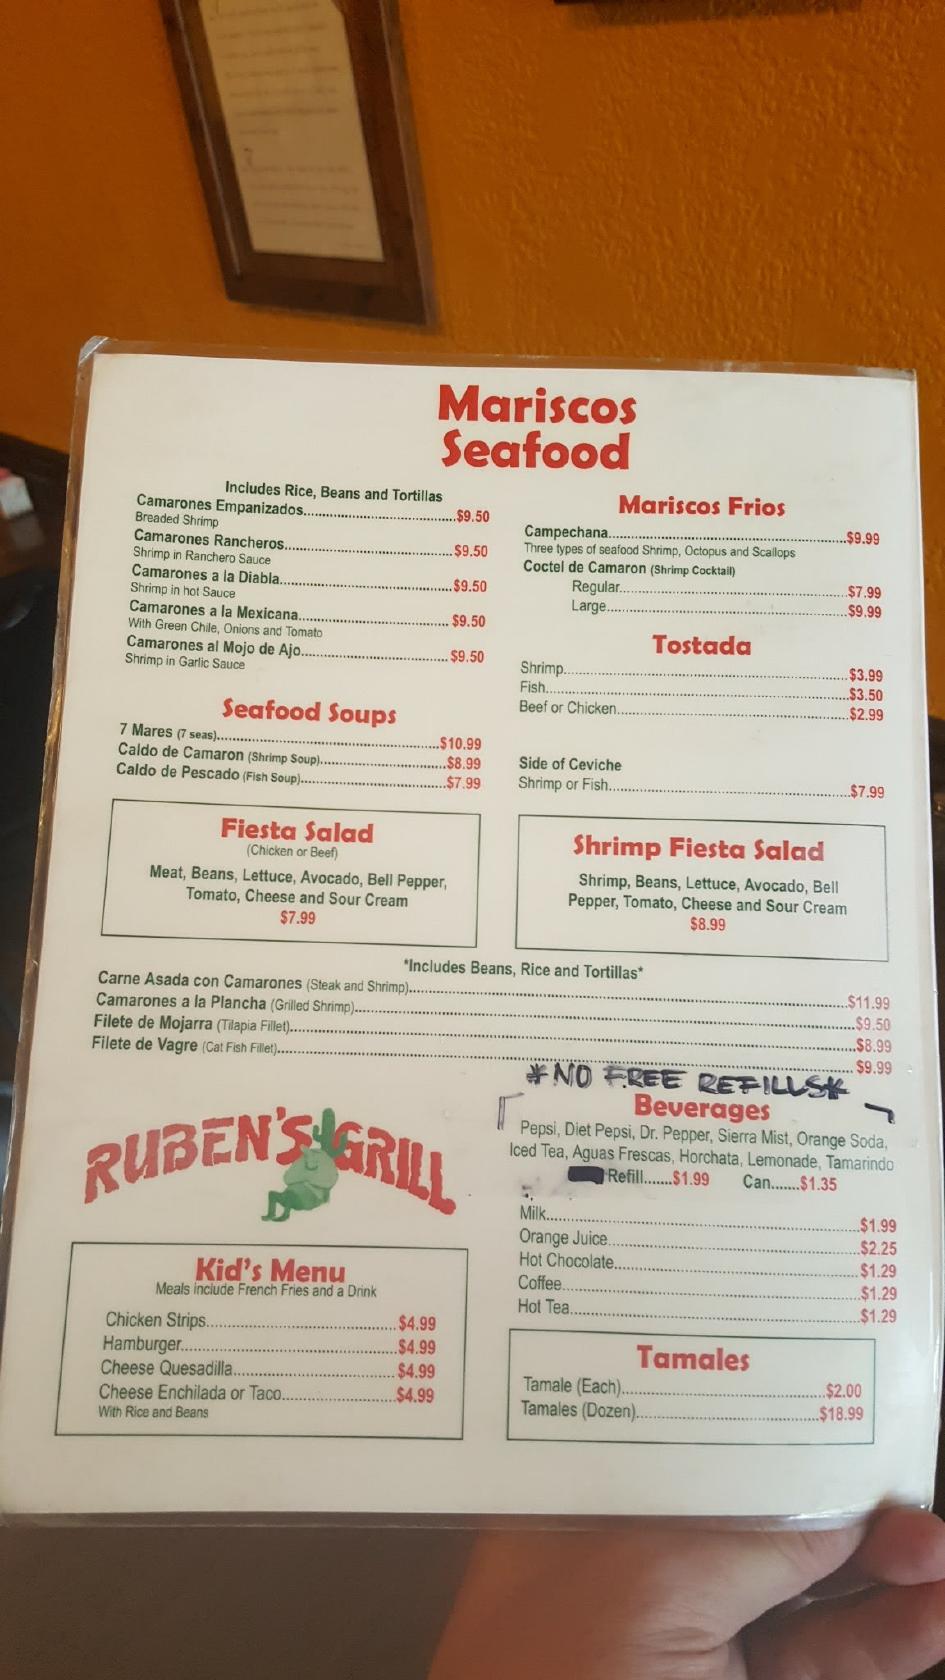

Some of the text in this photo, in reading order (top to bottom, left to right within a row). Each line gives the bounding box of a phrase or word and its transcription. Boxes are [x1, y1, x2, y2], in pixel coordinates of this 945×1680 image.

[438, 384, 636, 425] Mariscos
[442, 429, 630, 470] Seafood
[226, 481, 442, 502] Includes Rice, Beans and Tortillas
[137, 494, 490, 523] Camarones Empanizados $9.50
[619, 495, 785, 517] Mariscos Frios
[136, 511, 218, 529] Breaded Shrimp
[134, 528, 488, 558] Camarones Rancheros $9.50
[525, 524, 880, 545] Campechana $9.99
[524, 542, 796, 560] Three types of seafood Shrimp, Octopus and Scallops
[132, 564, 487, 592] Camarones a la Diabla $9.50
[524, 560, 735, 577] Coctel de Camaron (Shrimp Cocktail)
[572, 580, 881, 599] Regular $7.99
[128, 617, 322, 638] With Green Chile, Onions and Tomato
[652, 634, 751, 655] Tostada
[520, 660, 883, 682] Shrimp $3.99
[222, 698, 396, 728] Seafood Soups
[120, 723, 481, 750] 7 Mares (7 seas) $10.99
[118, 742, 481, 770] Caldo de Camaron (Shrimp Soup) $8.99
[519, 756, 622, 771] Side of Ceviche
[221, 817, 374, 843] Fiesta Salad
[247, 844, 338, 860] (Chicken or Beef)
[574, 834, 824, 861] Shrimp Fiesta Salad
[579, 873, 838, 895] Shrimp, Beans, Lettuce, Avocado, Bell
[569, 893, 847, 915] Pepper, Tomato, Cheese and Sour Cream
[280, 910, 316, 925] $7.99
[691, 916, 726, 931] $8.99
[471, 960, 516, 977] Beans,
[521, 962, 550, 976] Rice
[554, 964, 579, 977] and
[98, 970, 890, 1010] Carne Asada con Camarones (Steak and Shrimp) $11.99
[94, 1014, 892, 1053] Filete de Mojarra (Tilapia Fillet) $8.99
[603, 1065, 687, 1089] FREE
[634, 1093, 770, 1124] Beverages
[521, 1120, 887, 1150] Pepsi, Diet Pepsi, Dr. Pepper, Sierra Mist, Orange Soda,
[85, 1106, 456, 1215] RUBEN'S GRILL
[606, 1168, 837, 1192] Refill $1.99 Can $1.35
[520, 1205, 896, 1234] Milk $1.99
[520, 1228, 897, 1256] Orange Juice $2.25
[196, 1257, 345, 1283] Kid's Menu
[520, 1251, 896, 1279] Hot Chocolate $1.29
[106, 1311, 436, 1332] Chicken Strips $4.99
[101, 1359, 435, 1380] Cheese Quesadilla $4.99
[637, 1344, 750, 1372] Tamales
[523, 1376, 862, 1400] Tamale (Each) $2.00
[98, 1405, 208, 1418] With Rice and Beans
[521, 1400, 864, 1423] Tamales (Dozen) $18.99
